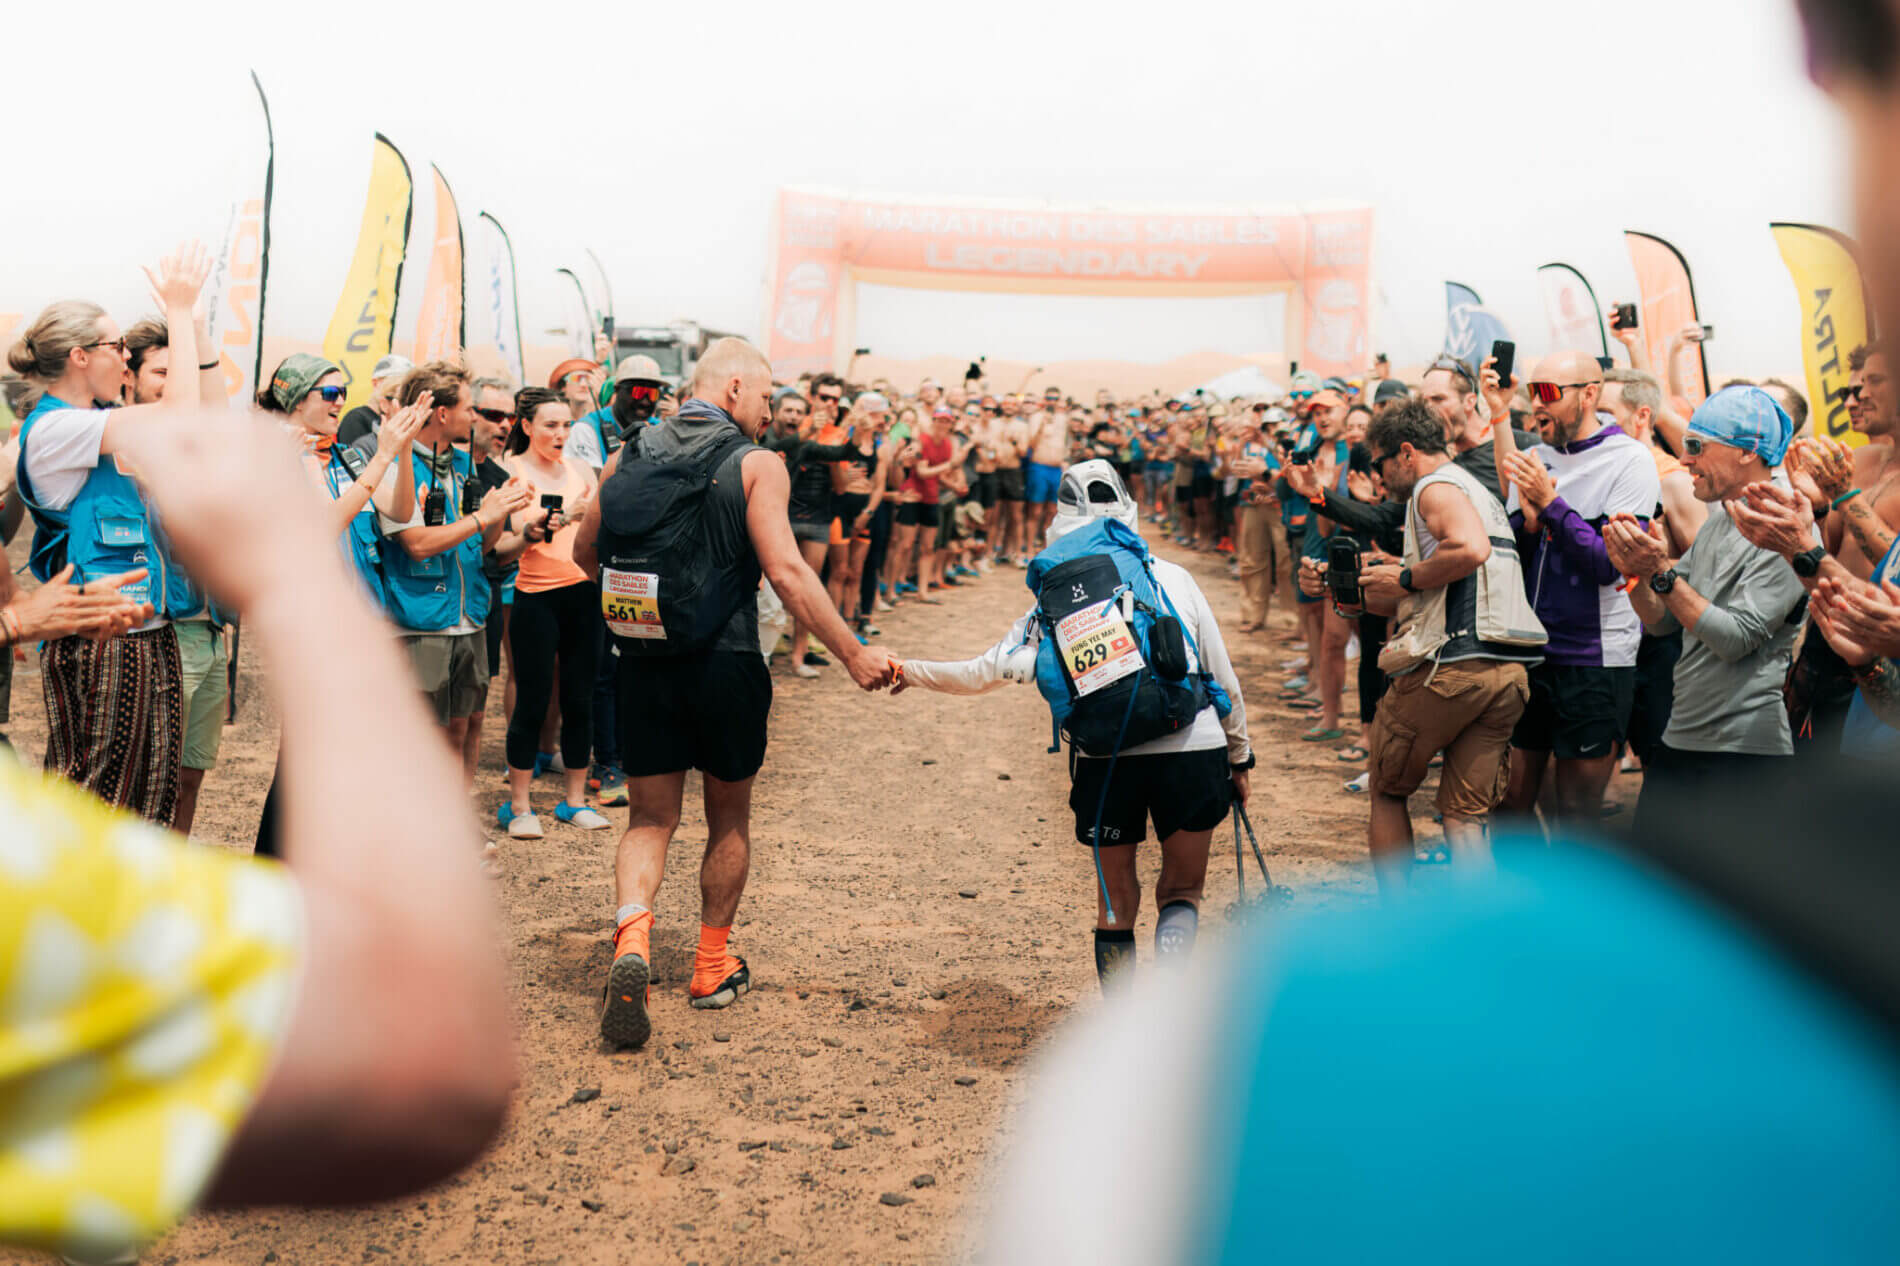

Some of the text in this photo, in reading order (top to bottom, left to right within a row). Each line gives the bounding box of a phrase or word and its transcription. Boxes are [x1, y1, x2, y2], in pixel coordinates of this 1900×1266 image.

[863, 207, 1059, 240] MARATHON
[1071, 217, 1136, 242] DES
[1145, 220, 1279, 246] SABLES
[925, 243, 1209, 278] LEGENDARY
[609, 573, 648, 583] MARATHON
[622, 581, 648, 590] SABLES
[608, 604, 637, 622] 561
[1071, 627, 1116, 654] FUNG YEE MAY
[1074, 643, 1107, 673] 629
[1103, 826, 1121, 841] T8
